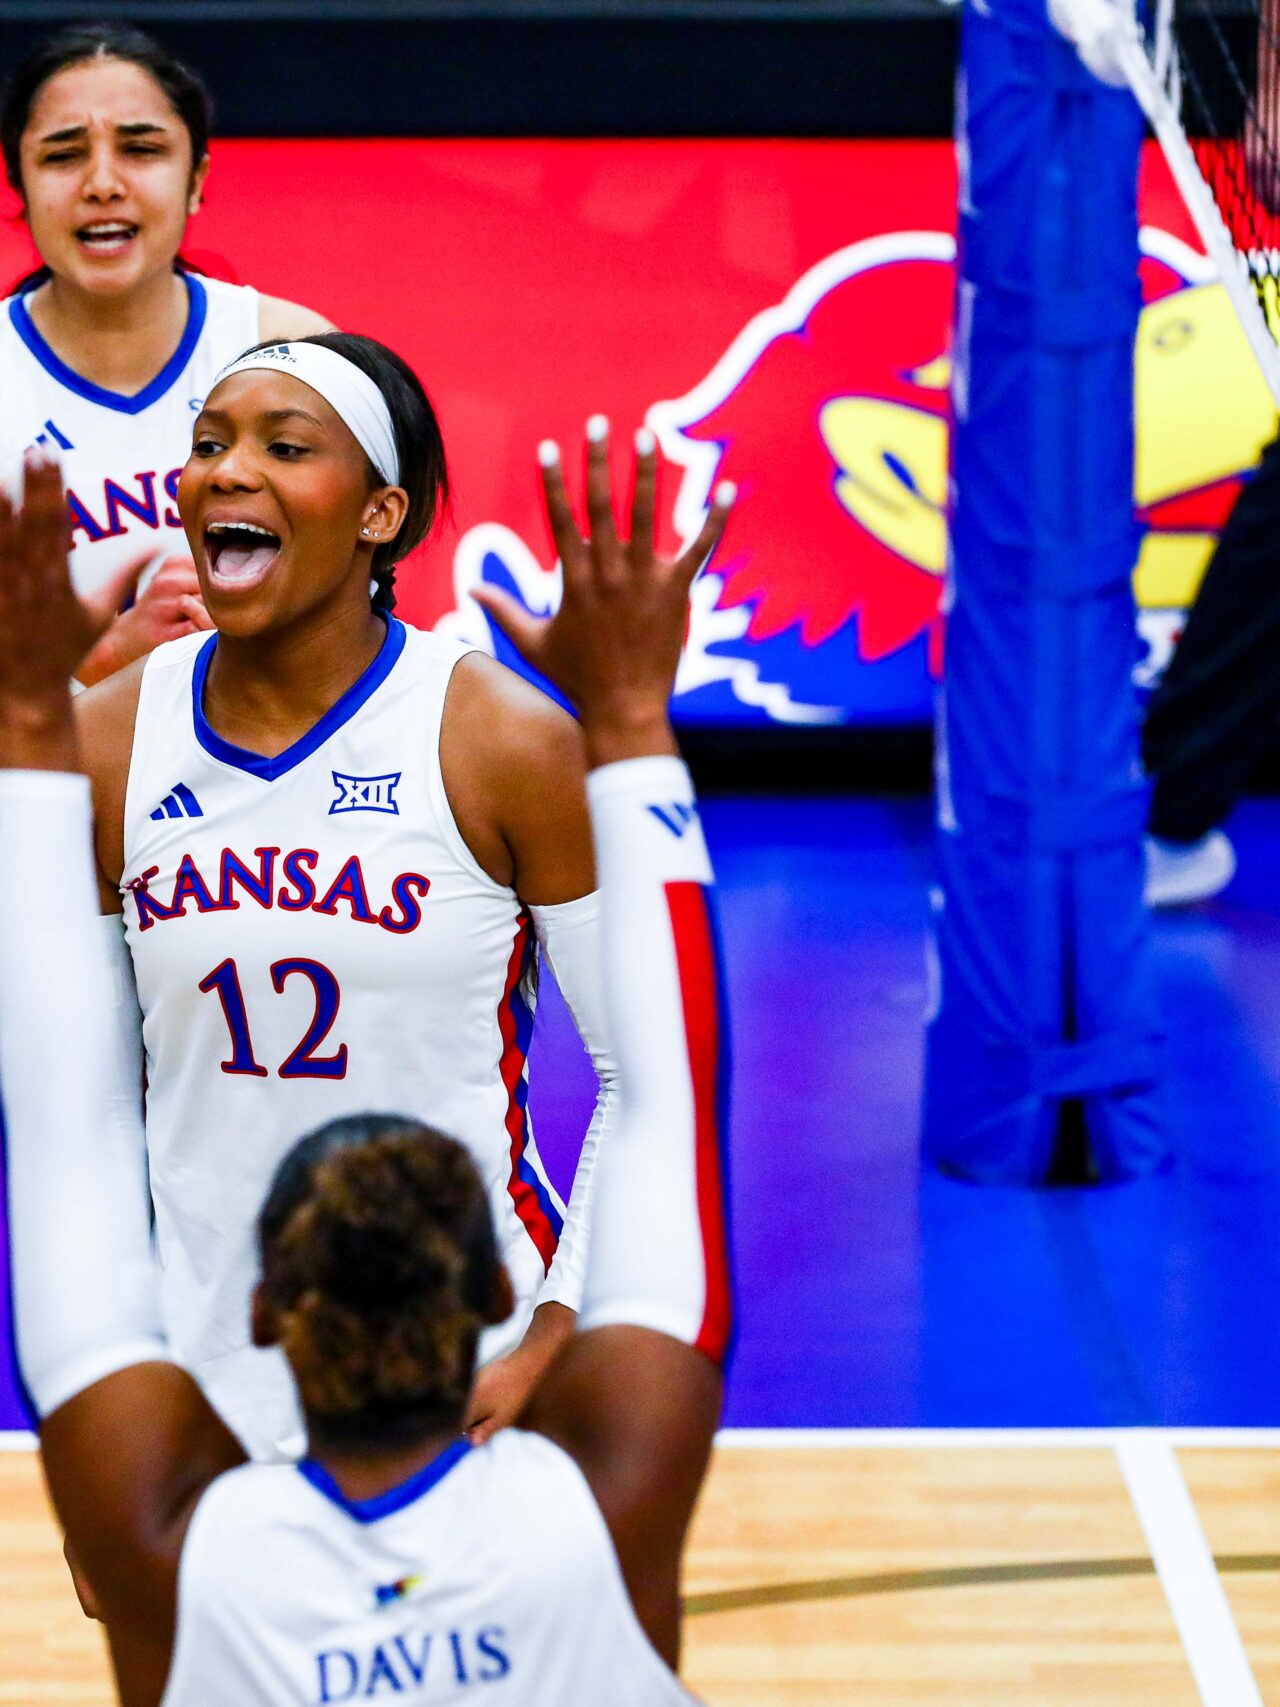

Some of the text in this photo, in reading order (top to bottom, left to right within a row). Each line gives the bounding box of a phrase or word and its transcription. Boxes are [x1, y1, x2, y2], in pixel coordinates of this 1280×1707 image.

[66, 468, 185, 549] ANS
[122, 846, 431, 934] KANSAS
[198, 957, 348, 1080] 12
[316, 1625, 511, 1704] DAVIS
